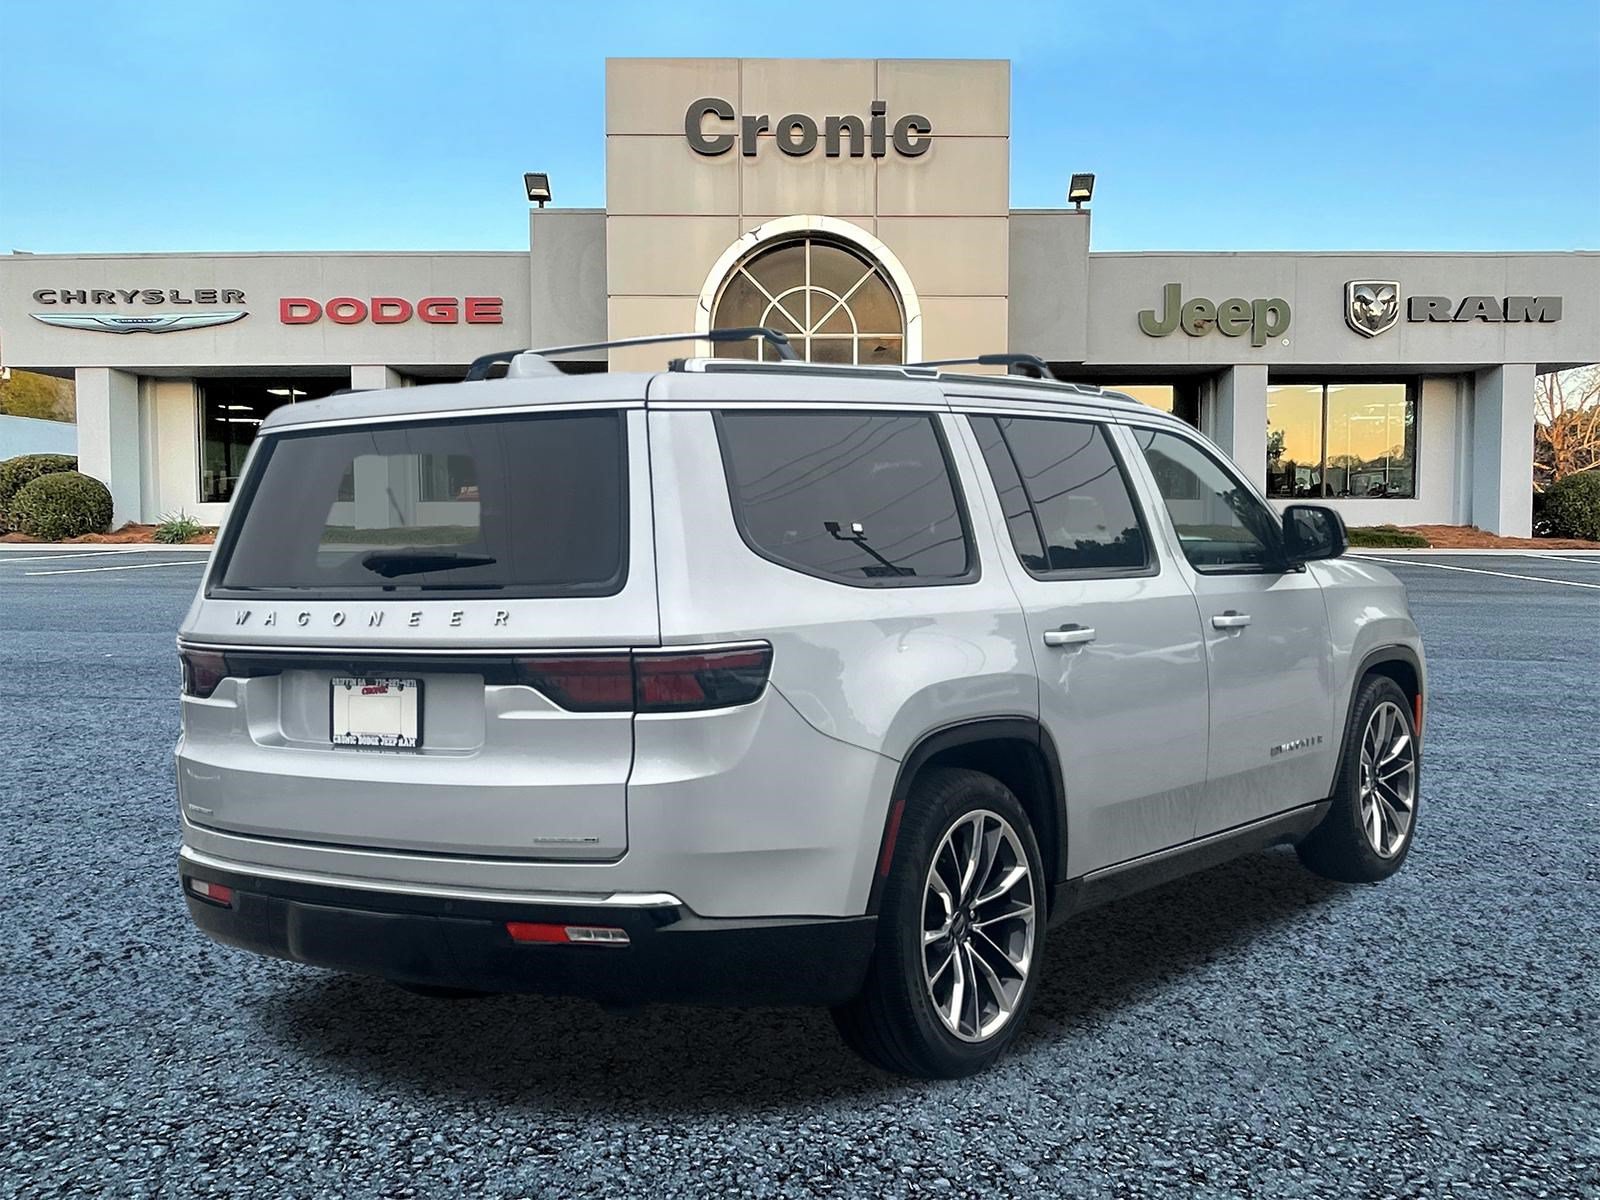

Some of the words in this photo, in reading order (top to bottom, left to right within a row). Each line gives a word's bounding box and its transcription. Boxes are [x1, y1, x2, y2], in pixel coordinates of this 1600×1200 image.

[685, 97, 932, 157] Cronic
[32, 289, 247, 305] CHRYSLER
[1407, 296, 1562, 322] RAM
[279, 297, 503, 324] DODGE
[1138, 283, 1291, 347] Jeep
[233, 610, 511, 627] WAGONEER
